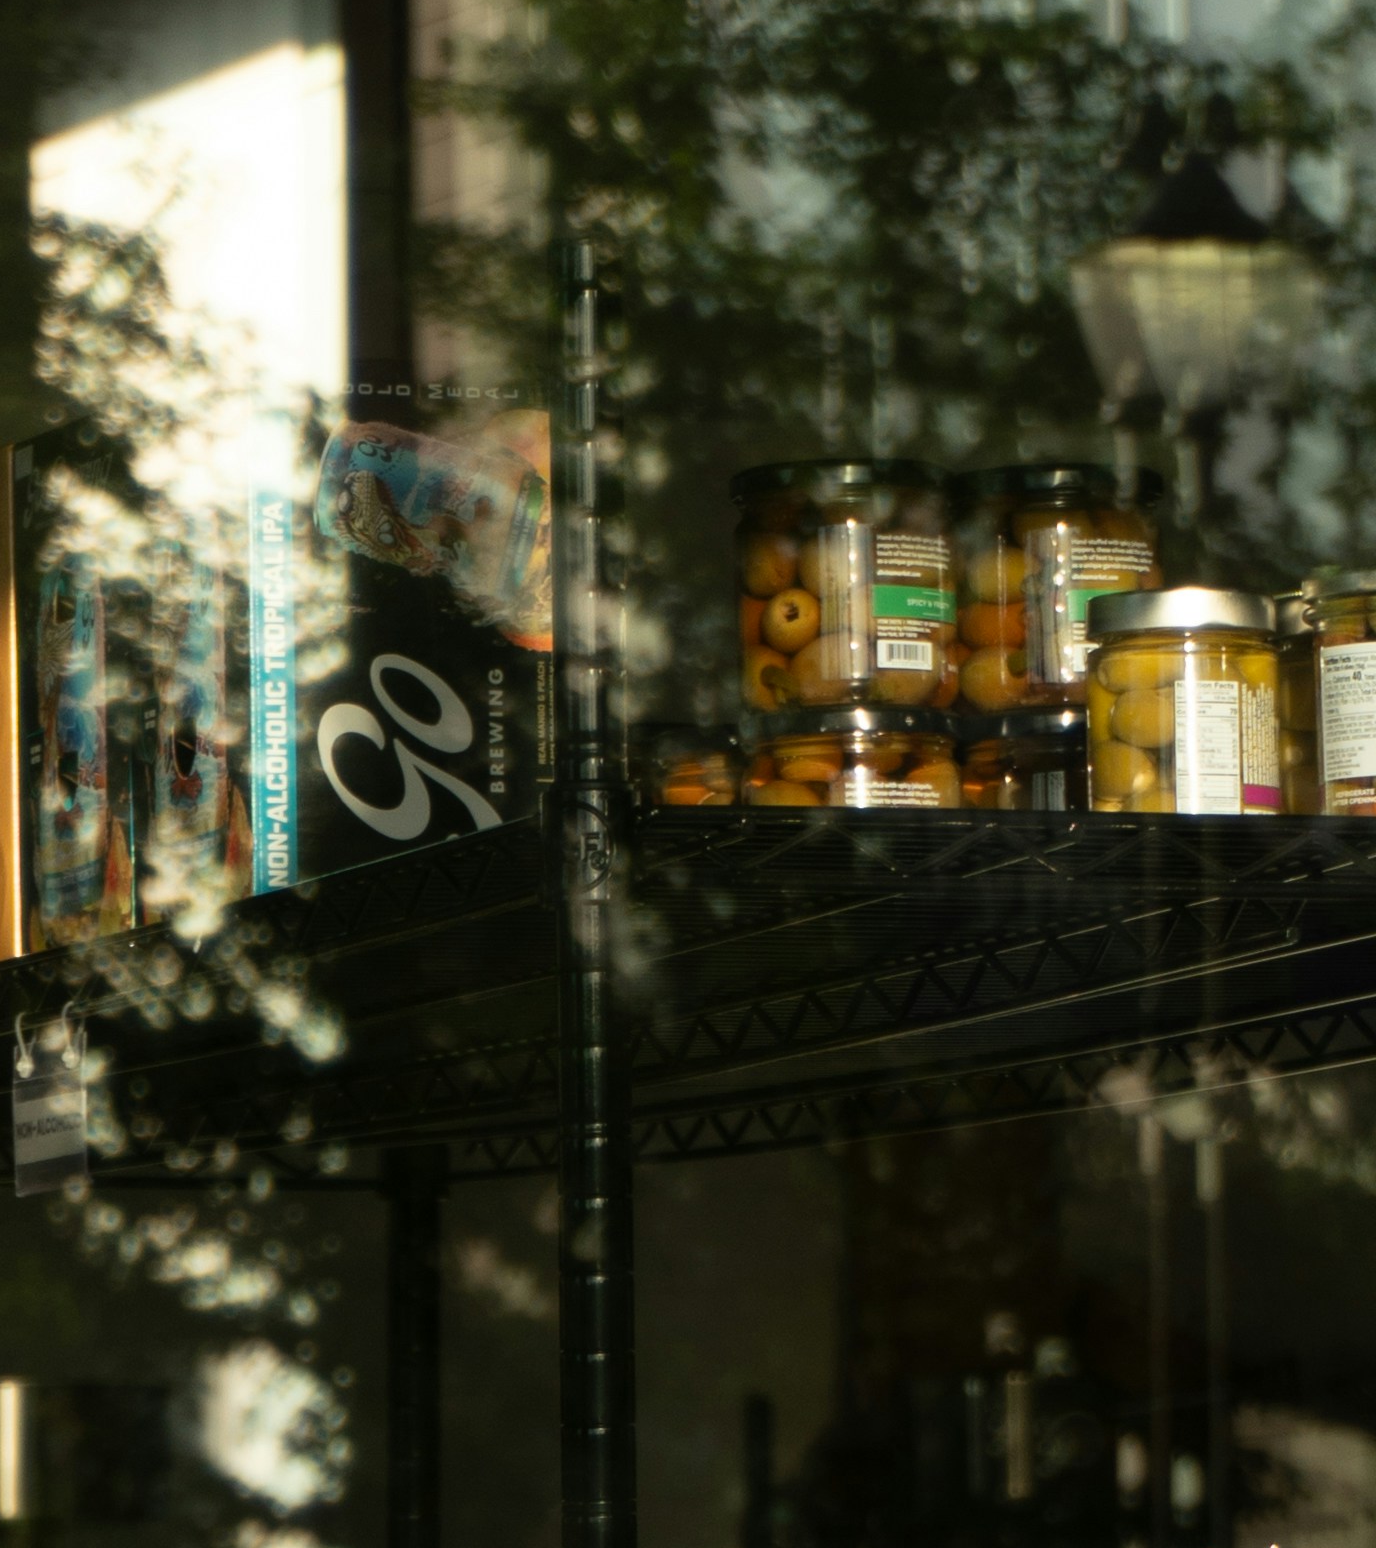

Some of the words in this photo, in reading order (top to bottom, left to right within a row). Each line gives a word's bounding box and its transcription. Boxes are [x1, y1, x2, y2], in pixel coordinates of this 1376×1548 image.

[262, 502, 284, 543] IPA
[263, 550, 286, 672] TROPICAL
[264, 682, 290, 888] NON-ALCOHOLIC
[489, 667, 505, 794] BREWING
